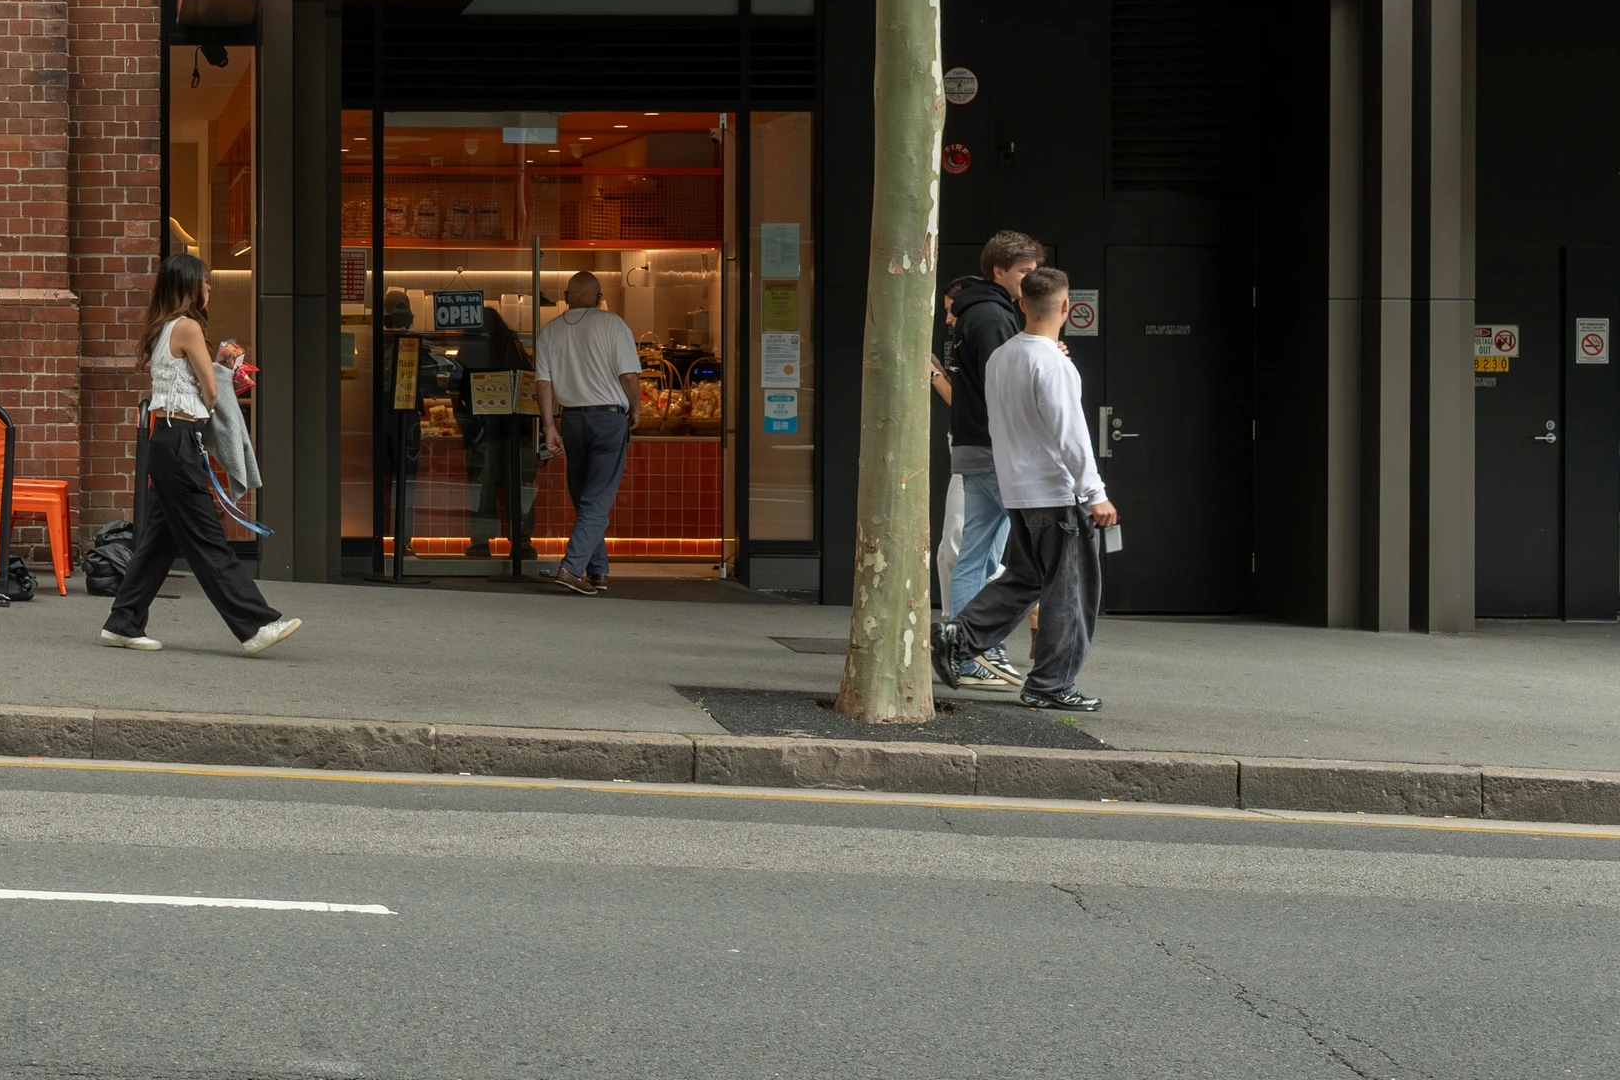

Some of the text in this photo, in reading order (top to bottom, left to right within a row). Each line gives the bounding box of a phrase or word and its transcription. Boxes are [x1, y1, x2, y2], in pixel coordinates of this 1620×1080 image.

[945, 144, 968, 155] FIRE
[437, 306, 481, 325] OPEN
[1479, 346, 1491, 354] OUT
